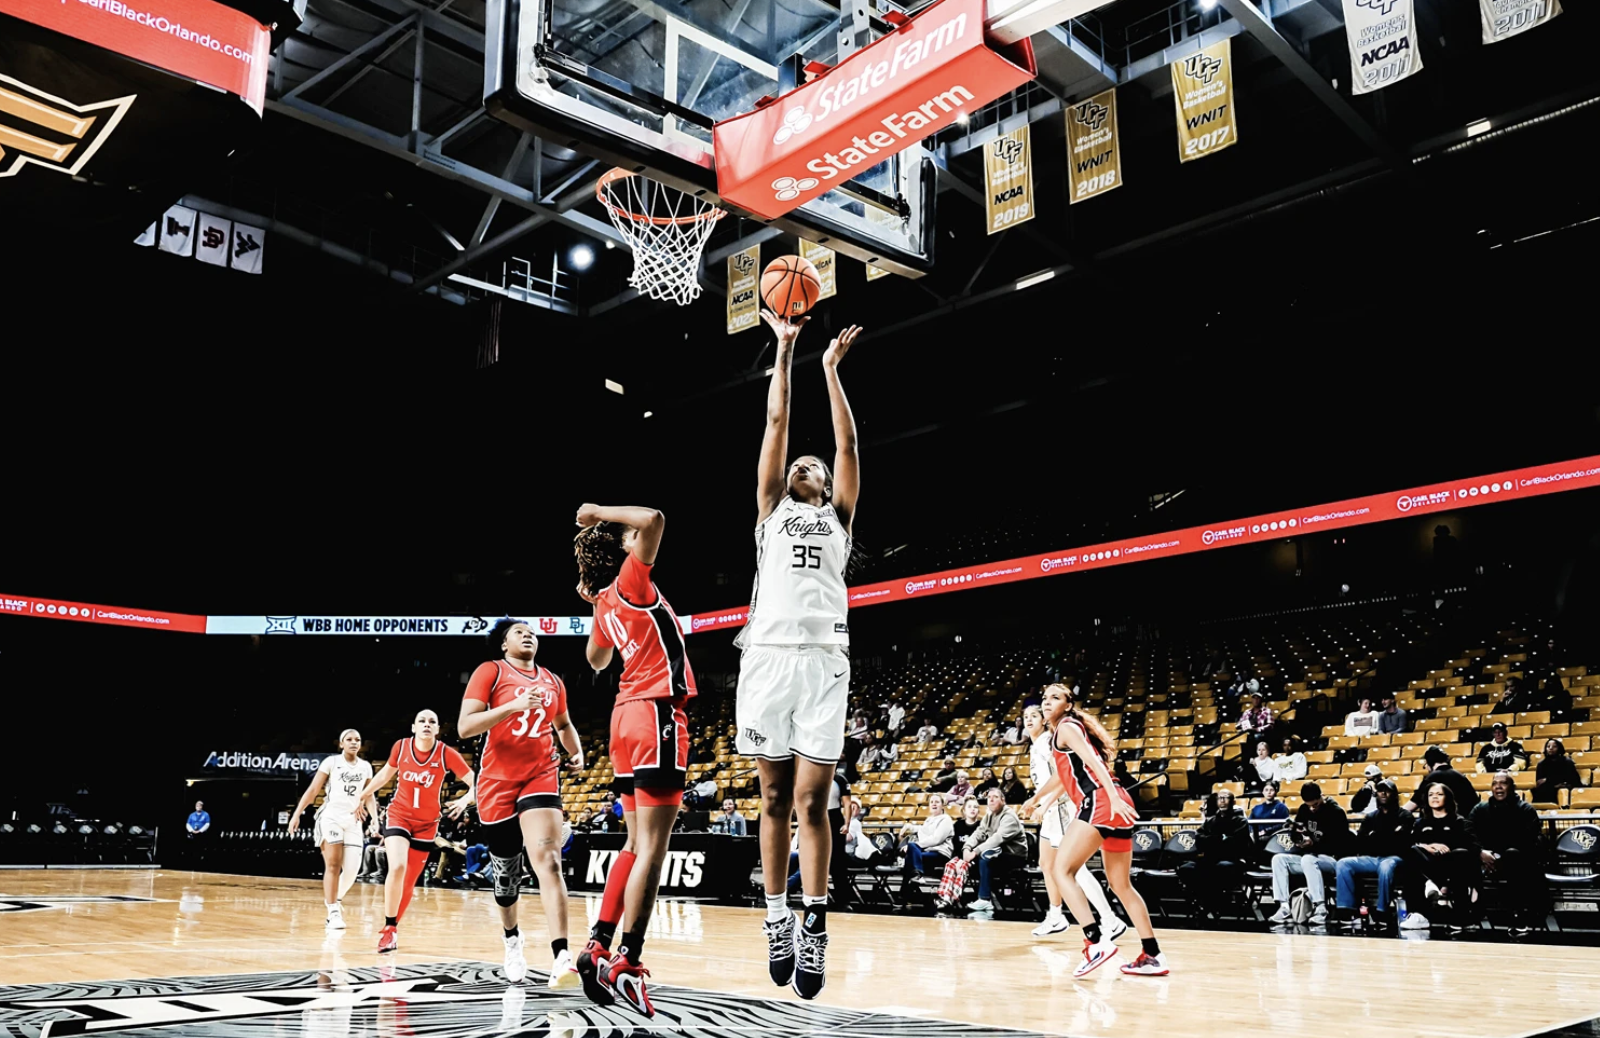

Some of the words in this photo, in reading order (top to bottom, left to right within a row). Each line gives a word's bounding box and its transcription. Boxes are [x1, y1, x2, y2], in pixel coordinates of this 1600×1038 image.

[1361, 36, 1410, 67] NCAA
[1185, 53, 1222, 84] UCF
[1363, 54, 1410, 88] 2011
[1183, 85, 1227, 110] Basketball
[1075, 100, 1109, 131] UCF
[1186, 104, 1227, 131] WNIT
[993, 136, 1023, 164] UCF
[1185, 125, 1230, 155] 2017
[1077, 149, 1113, 174] WNIT
[994, 185, 1024, 205] NCAA
[1076, 169, 1116, 197] 2018
[993, 202, 1029, 228] 2019
[731, 290, 754, 306] NCAA
[1429, 491, 1450, 500] BLACK
[777, 516, 834, 539] Knights
[792, 545, 822, 570] 35
[303, 618, 332, 632] WBB
[335, 618, 371, 632] HOME
[373, 618, 449, 632] OPPONENTS
[511, 708, 547, 738] 32
[744, 727, 767, 747] UCF
[203, 751, 272, 768] Addition
[272, 752, 321, 771] Arena
[343, 785, 357, 796] 42
[412, 787, 420, 809] 1
[1570, 830, 1597, 850] UCF
